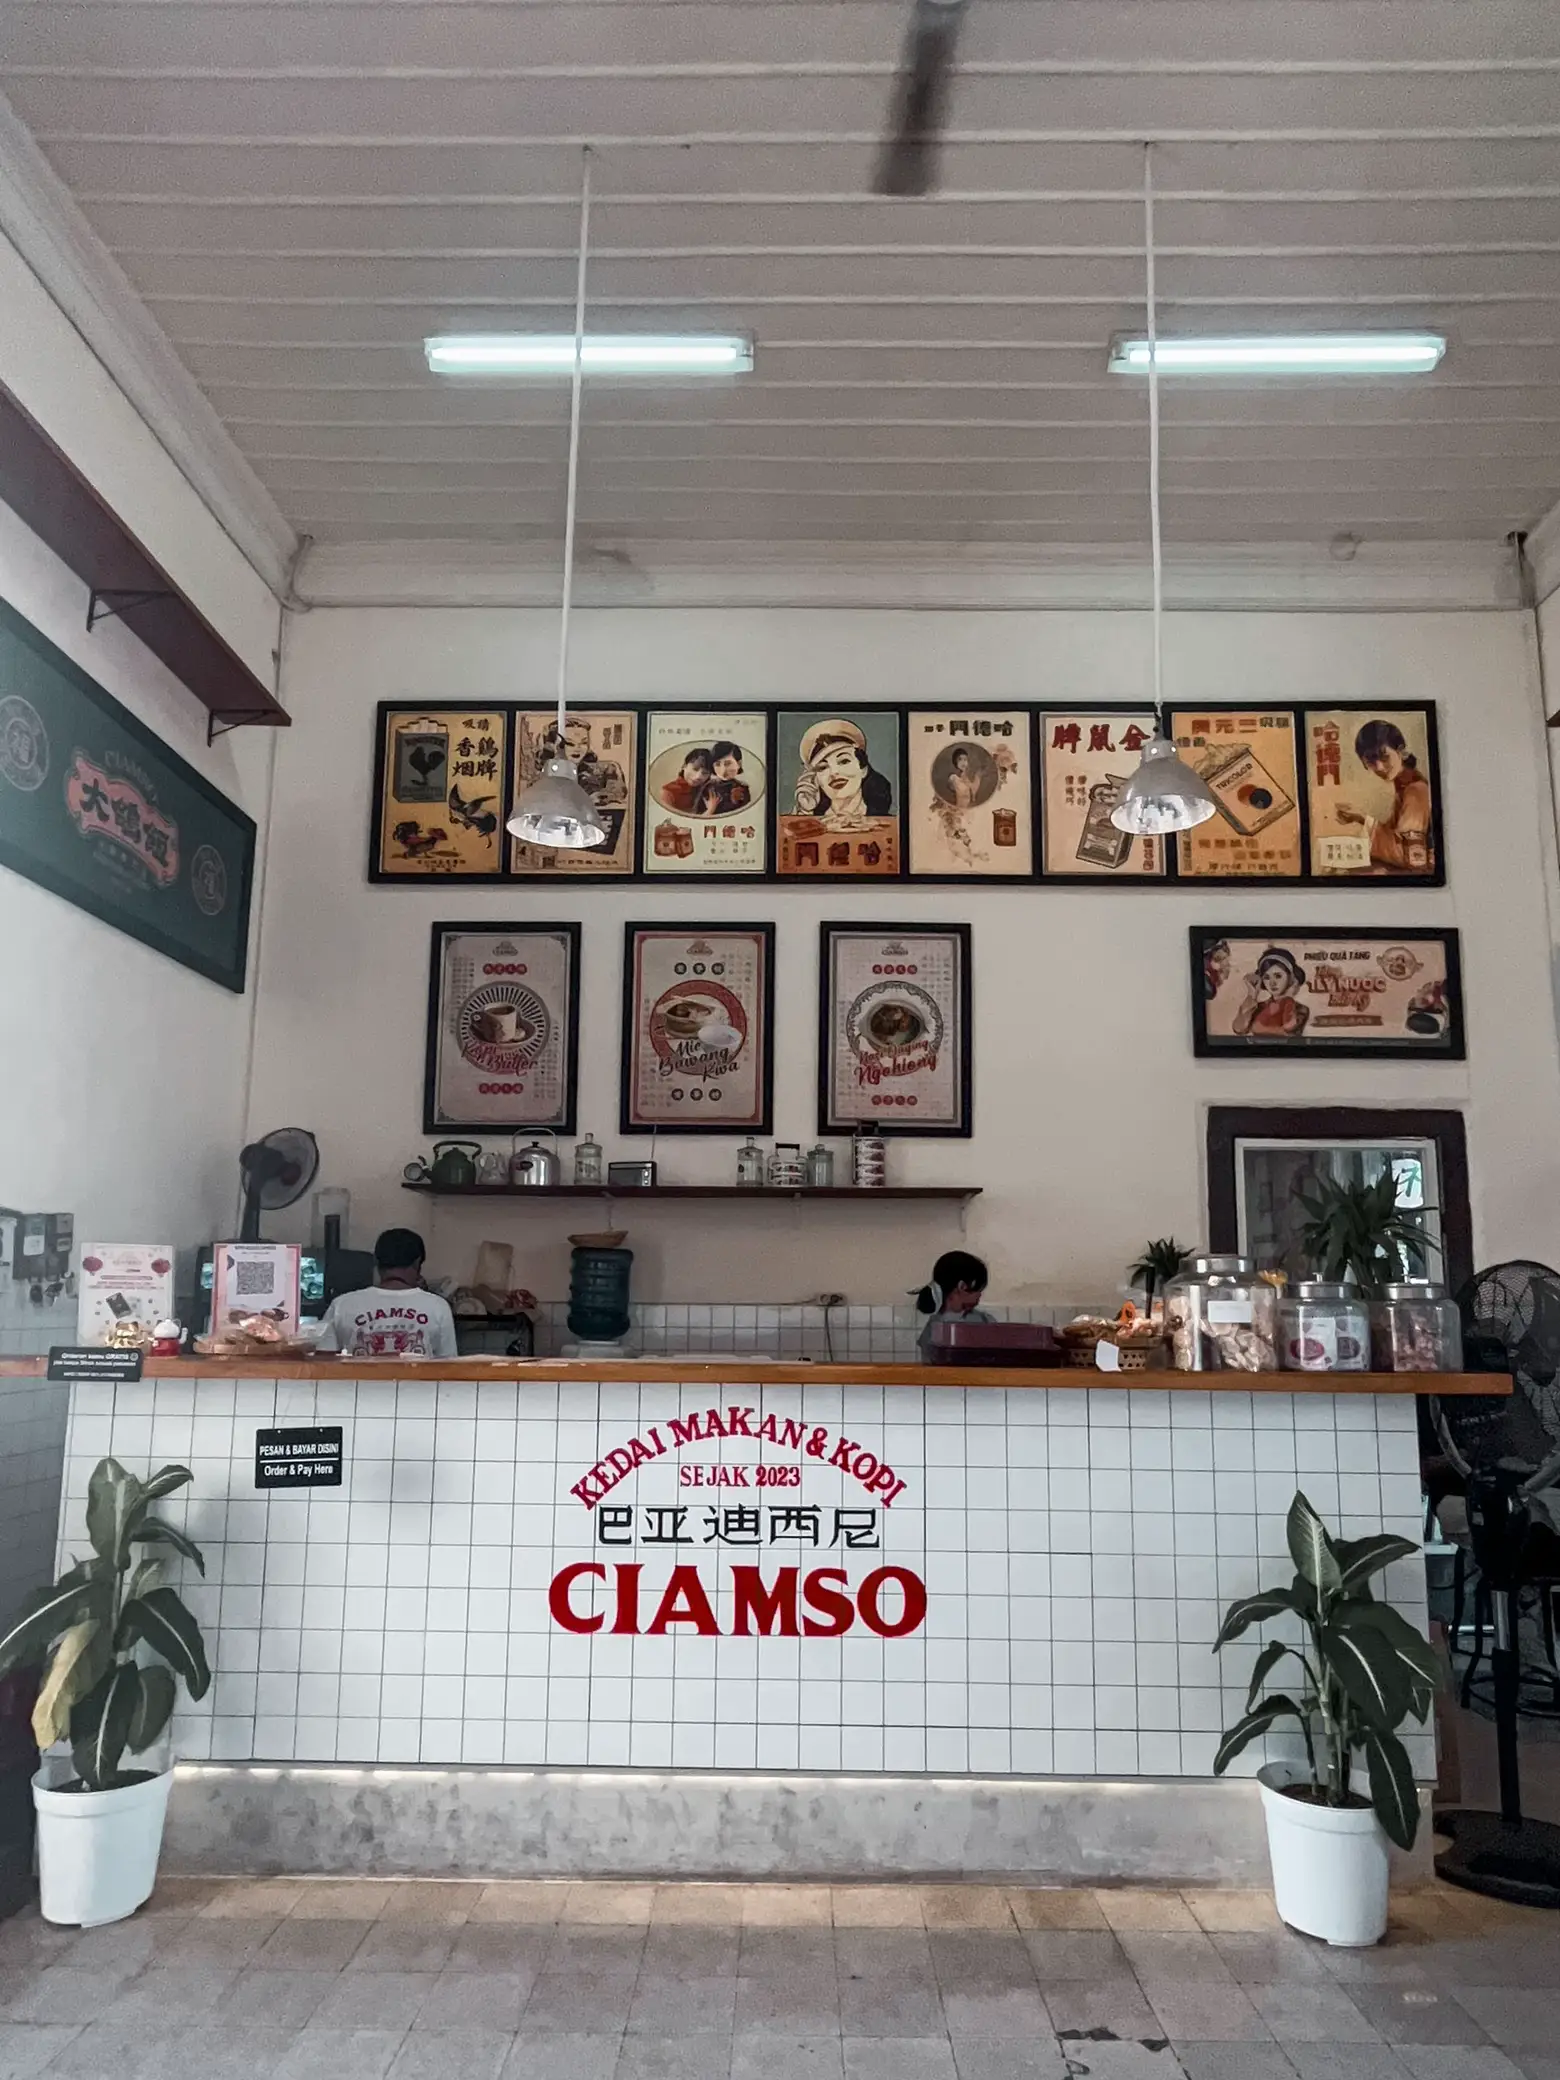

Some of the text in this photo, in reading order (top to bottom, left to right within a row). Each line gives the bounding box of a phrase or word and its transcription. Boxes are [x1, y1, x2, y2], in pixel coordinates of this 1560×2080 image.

[658, 1047, 730, 1076] Bawang
[354, 1307, 429, 1327] CIAMSO
[260, 1443, 339, 1456] PESAN & BAYAR DISINI
[569, 1405, 908, 1511] KEDAI MAKAN & KOPI
[264, 1463, 334, 1478] Order & Pay Here
[679, 1464, 801, 1488] SEJAK 2023
[597, 1503, 880, 1549] 巴亚迪西尼
[548, 1561, 928, 1639] CIAMSO
